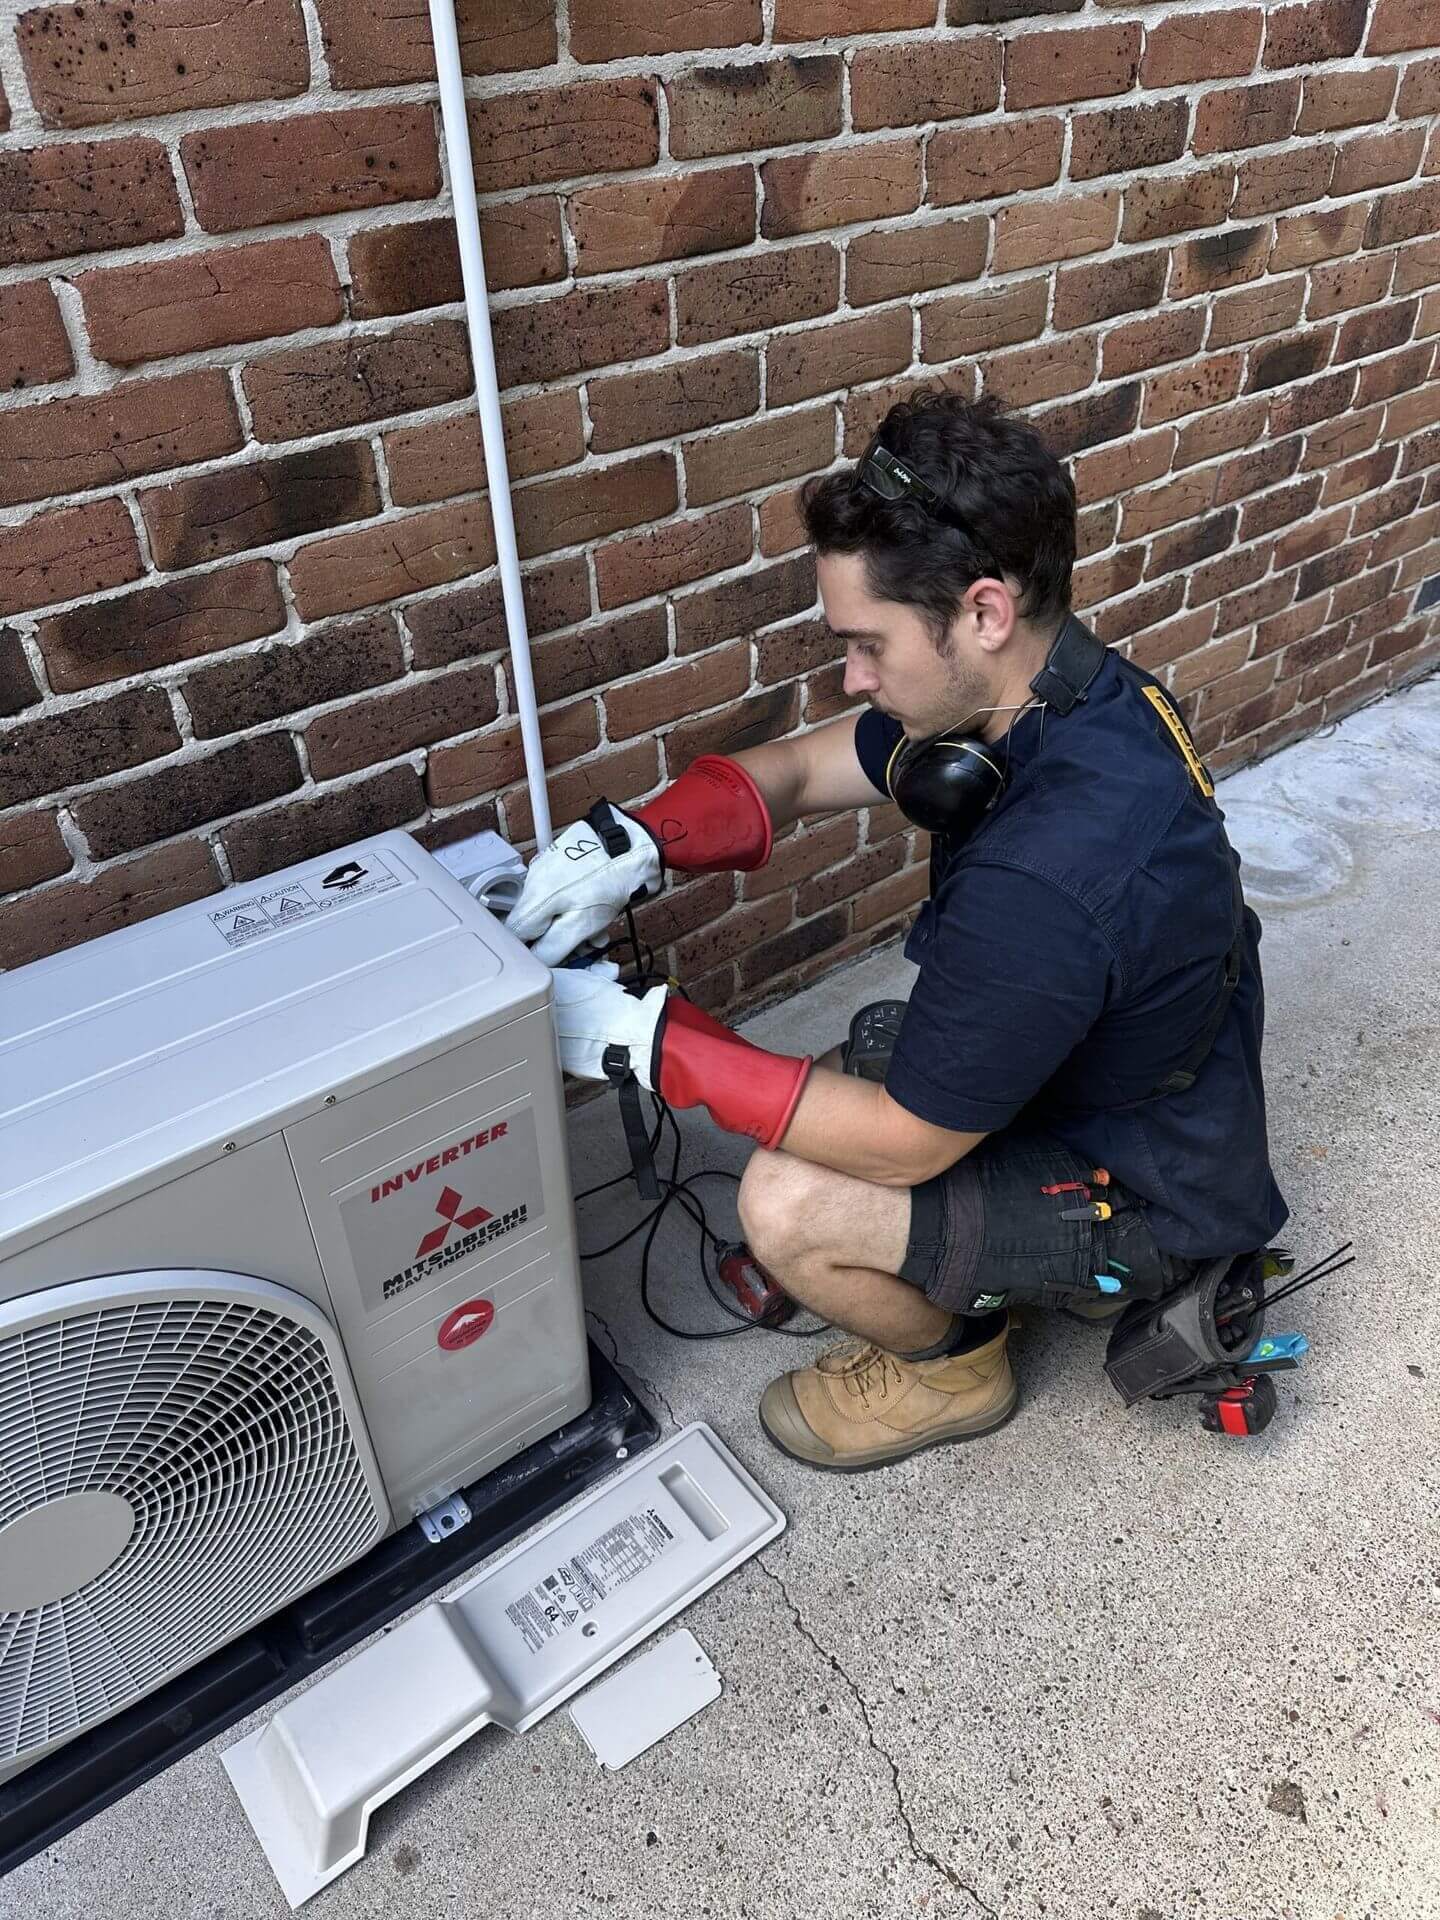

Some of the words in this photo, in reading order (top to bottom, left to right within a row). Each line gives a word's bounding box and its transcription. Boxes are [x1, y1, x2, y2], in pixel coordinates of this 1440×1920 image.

[564, 839, 601, 861] B
[269, 884, 300, 899] CAUTION
[221, 900, 255, 917] WARNING
[371, 1121, 508, 1203] INVERTER
[383, 1204, 527, 1293] MITSUBISHI
[384, 1267, 433, 1300] HEAVY
[438, 1214, 528, 1270] INDUSTRIES
[544, 1605, 560, 1622] 64
